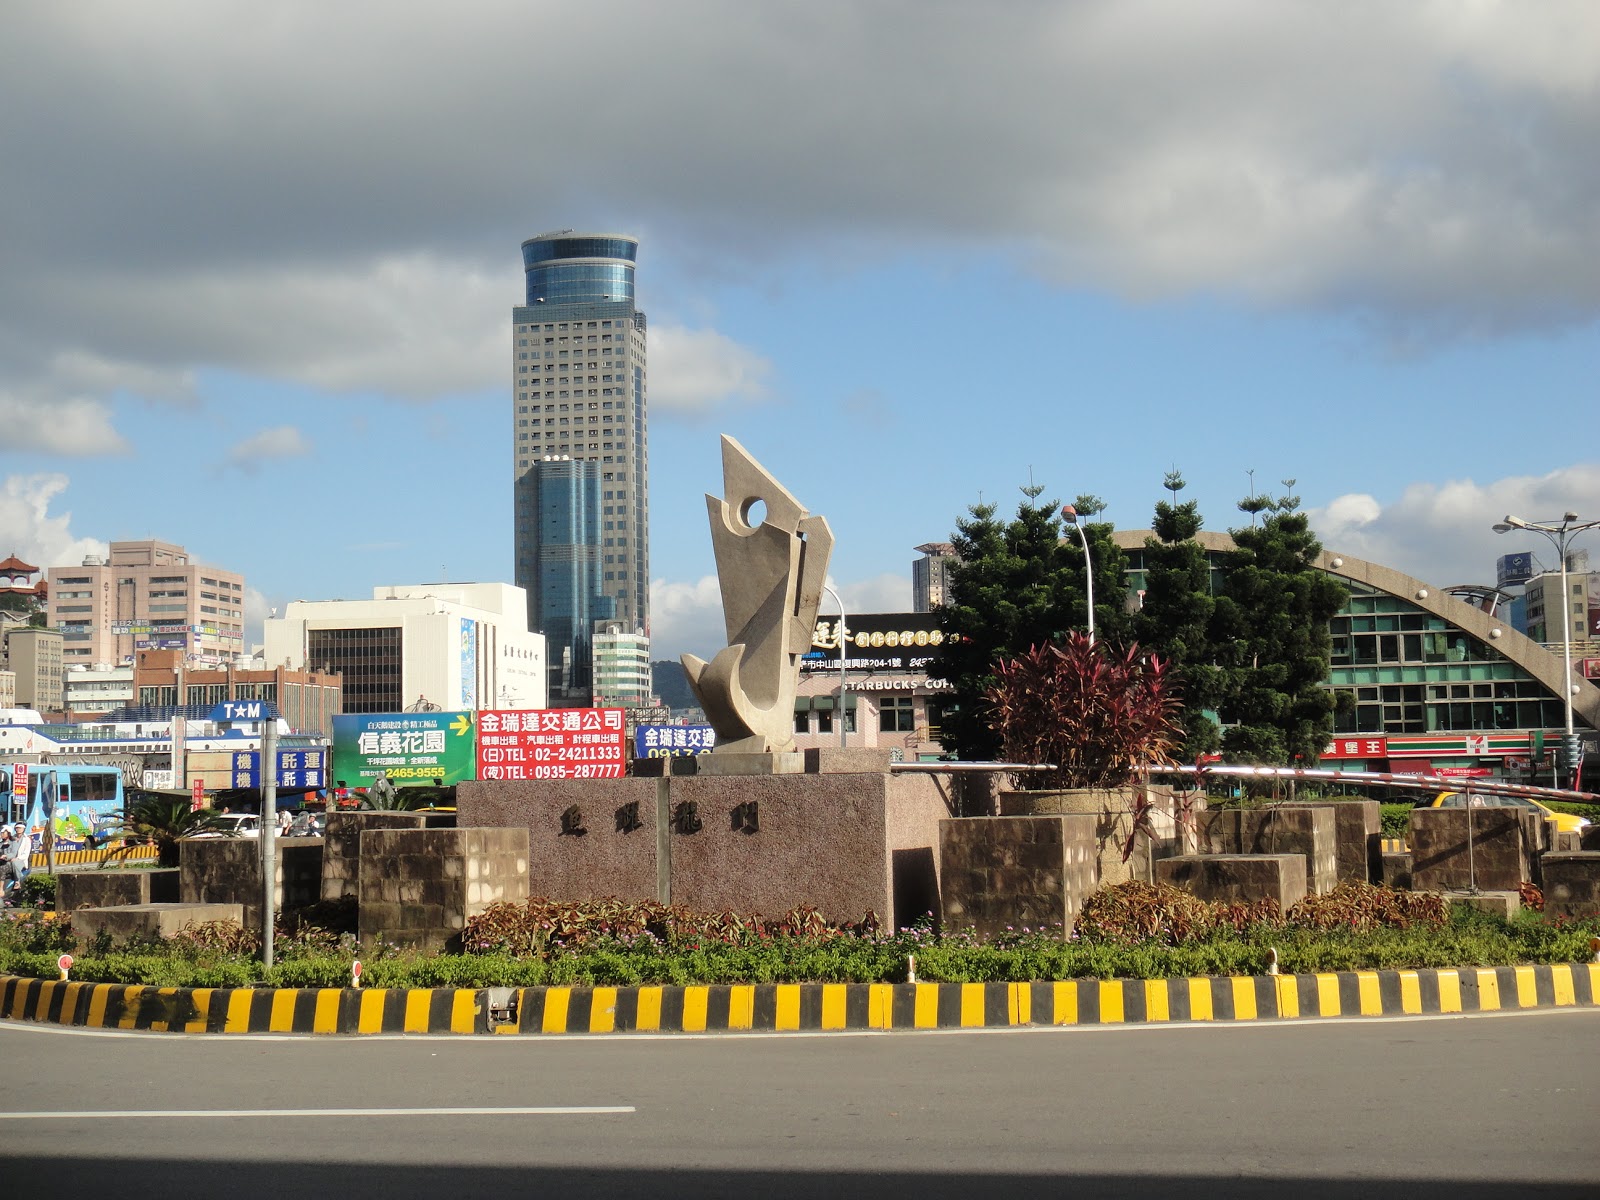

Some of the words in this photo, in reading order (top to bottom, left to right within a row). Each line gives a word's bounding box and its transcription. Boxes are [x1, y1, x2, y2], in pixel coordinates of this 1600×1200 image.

[480, 710, 622, 733] 金瑞達交通公司
[357, 729, 446, 755] 信義花園
[385, 767, 446, 778] 2465-9555
